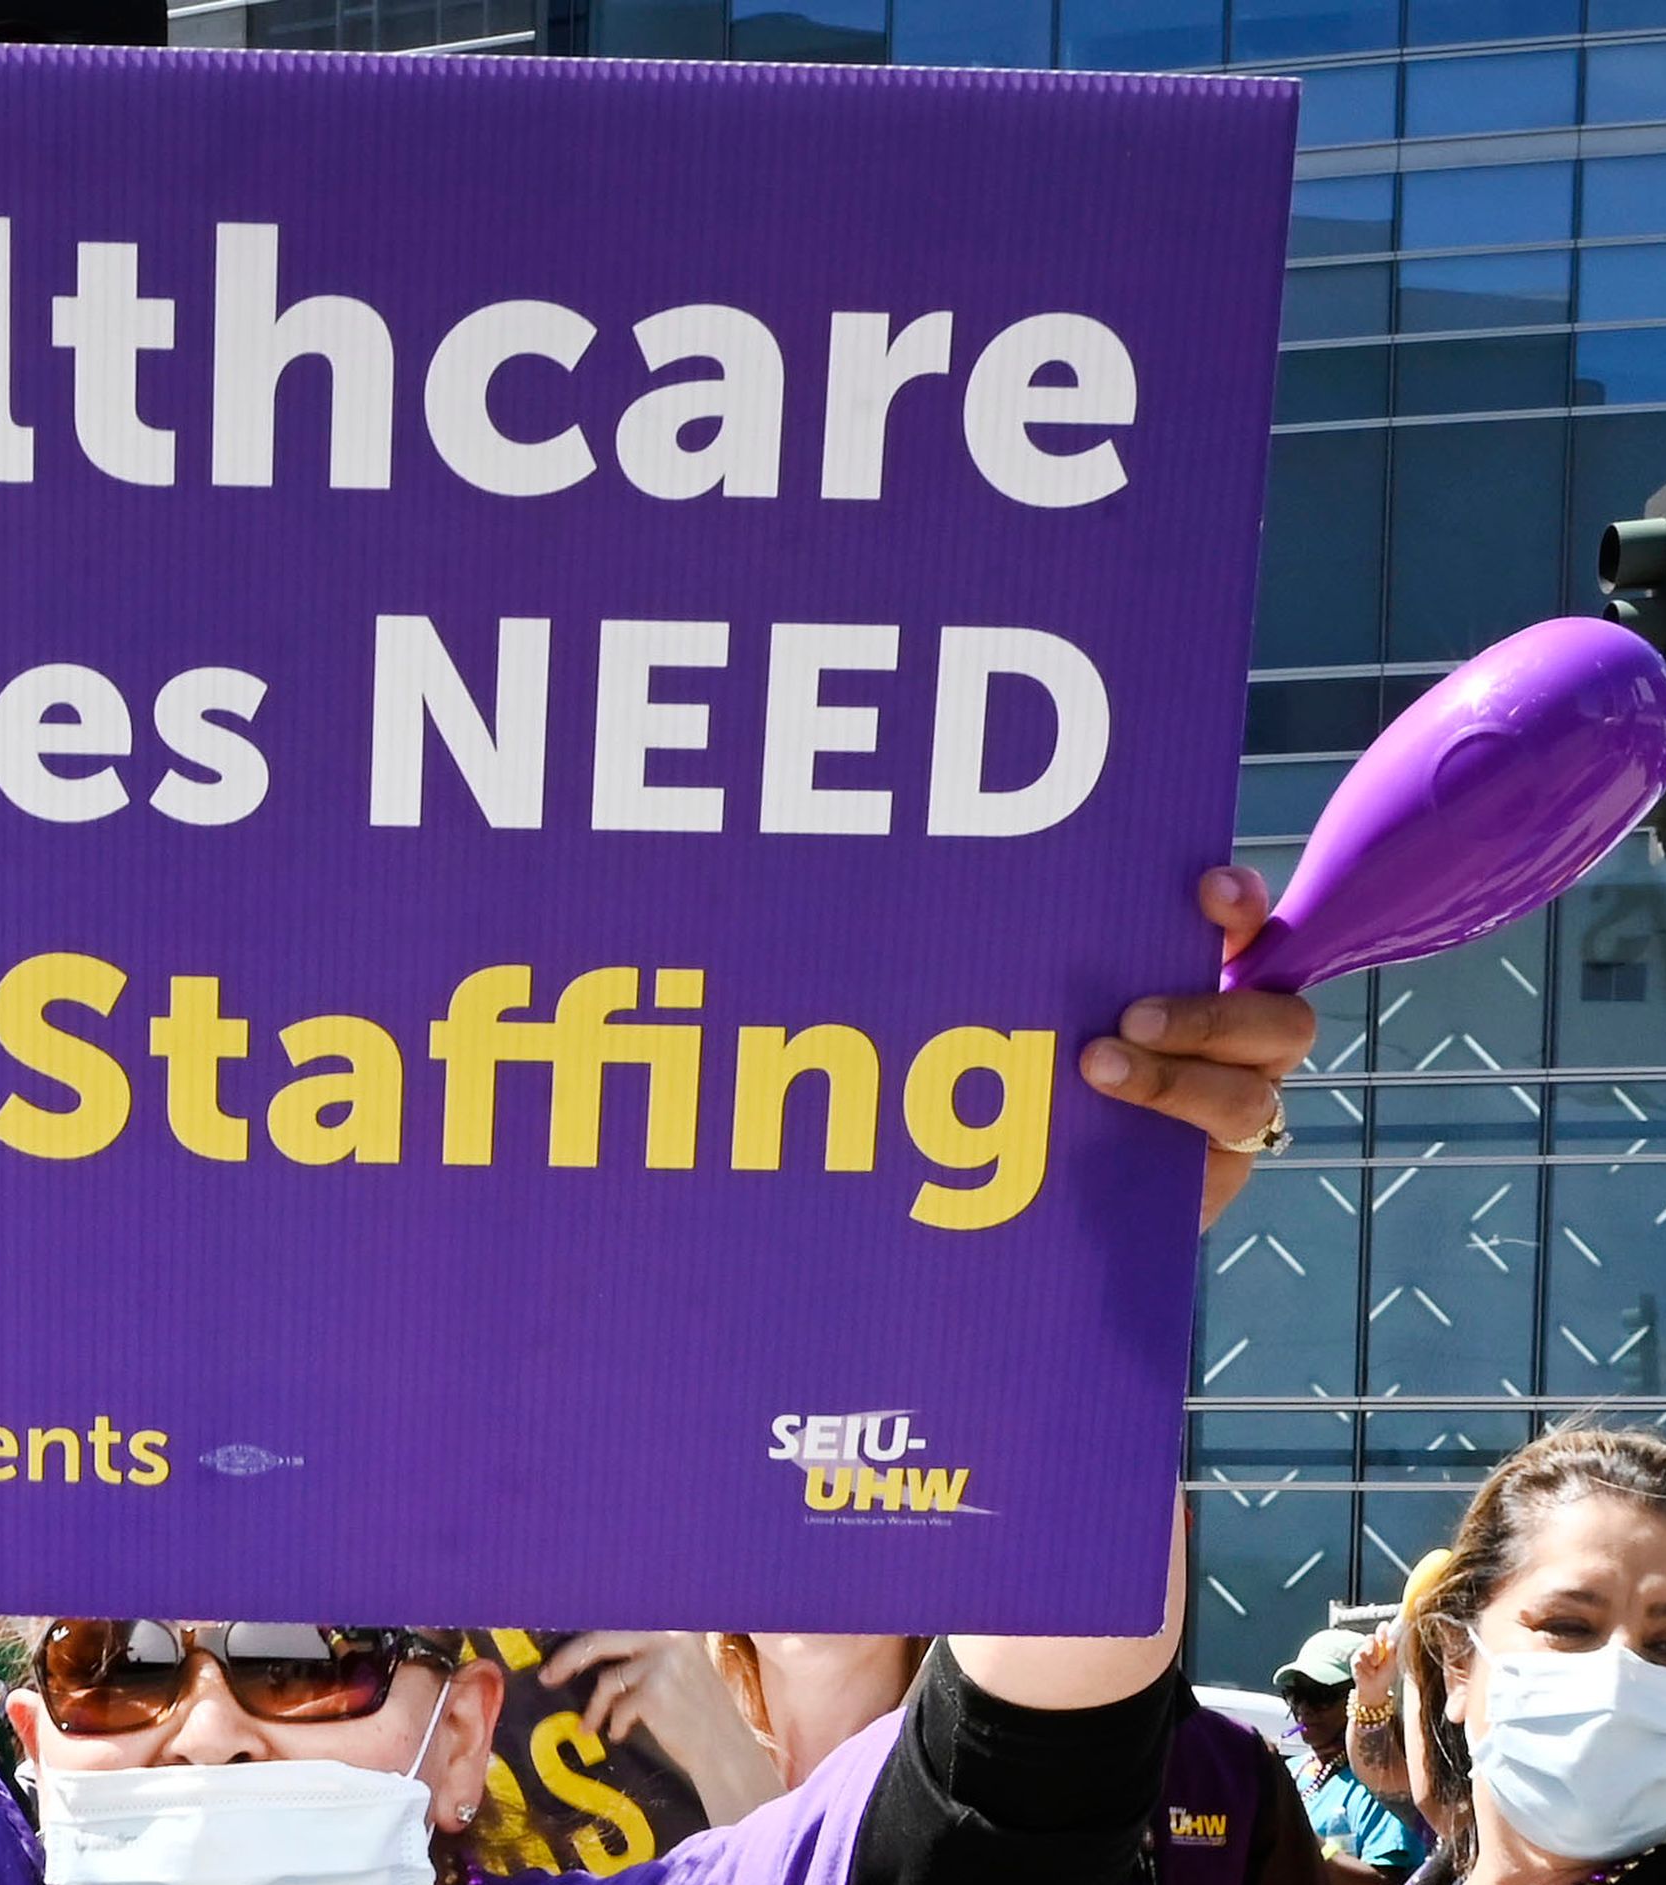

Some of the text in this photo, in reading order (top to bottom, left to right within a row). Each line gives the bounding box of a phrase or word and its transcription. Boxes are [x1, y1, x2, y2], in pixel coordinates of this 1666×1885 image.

[369, 614, 1110, 837] NEED
[769, 1414, 926, 1462] SEIU-
[805, 1466, 970, 1512] UHW
